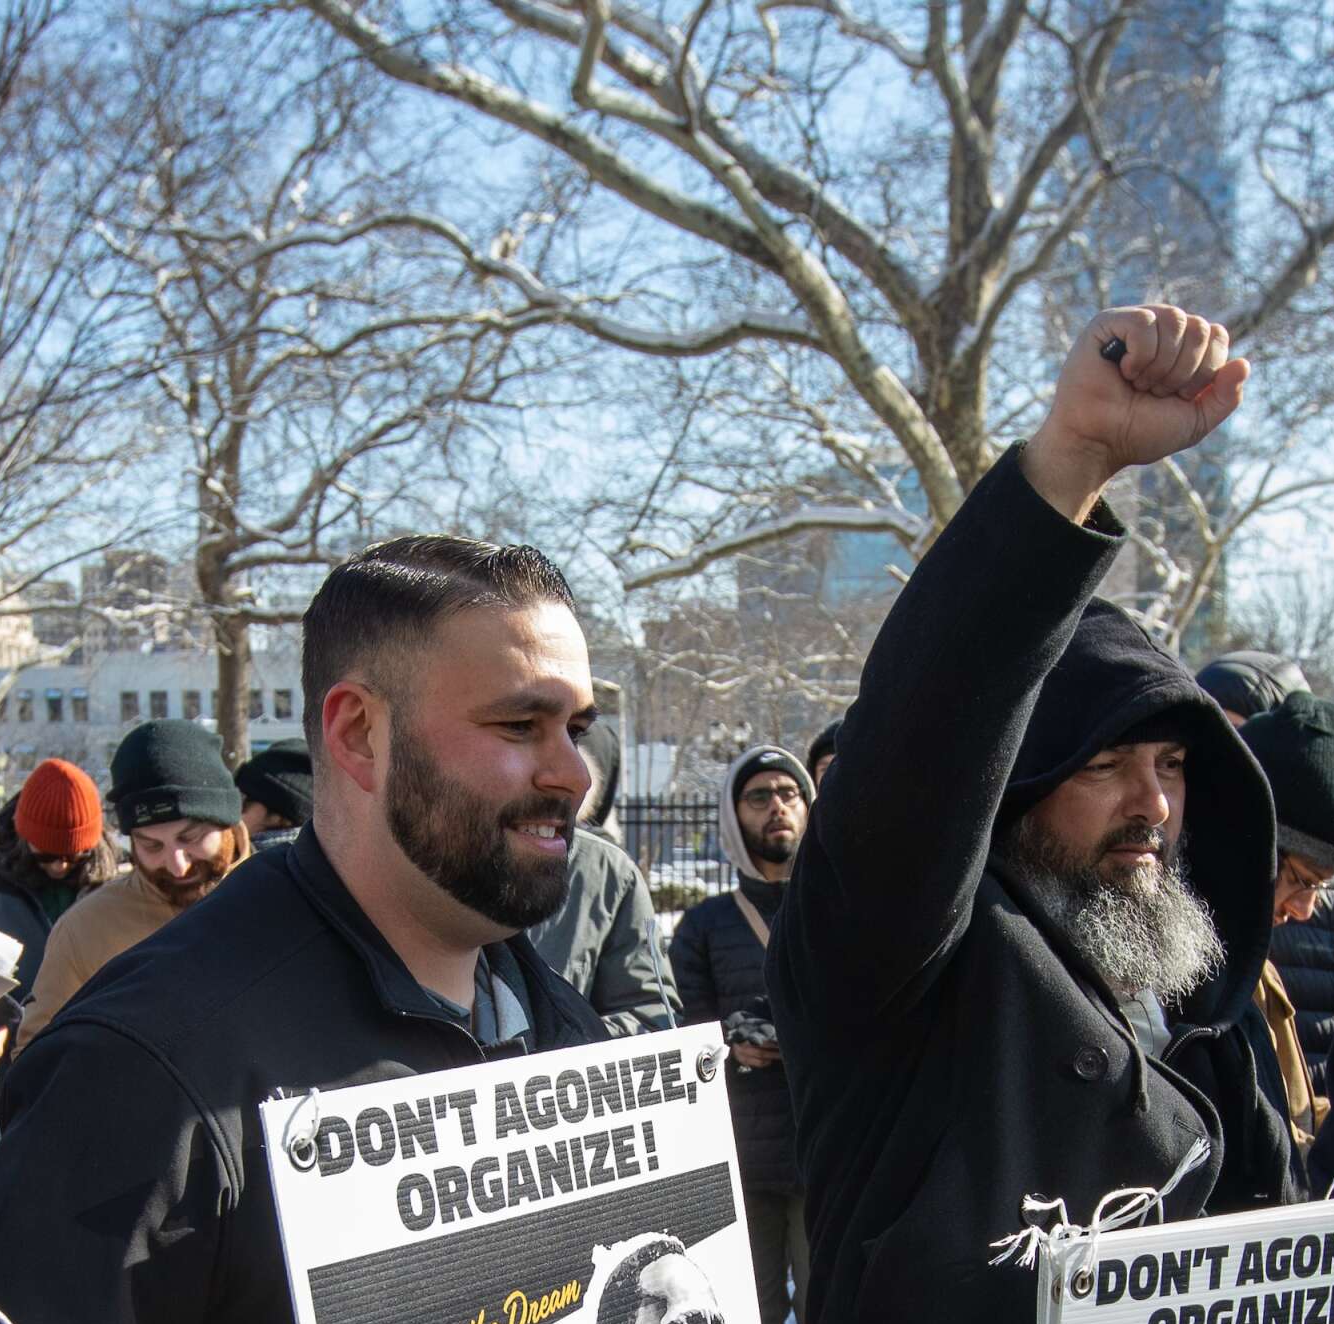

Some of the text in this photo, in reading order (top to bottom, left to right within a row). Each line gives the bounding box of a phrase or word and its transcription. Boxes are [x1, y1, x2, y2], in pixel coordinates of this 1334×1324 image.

[315, 1049, 698, 1177] DON'T AGONIZE,
[396, 1120, 659, 1232] ORGANIZE!
[1096, 1245, 1230, 1306] DON'T
